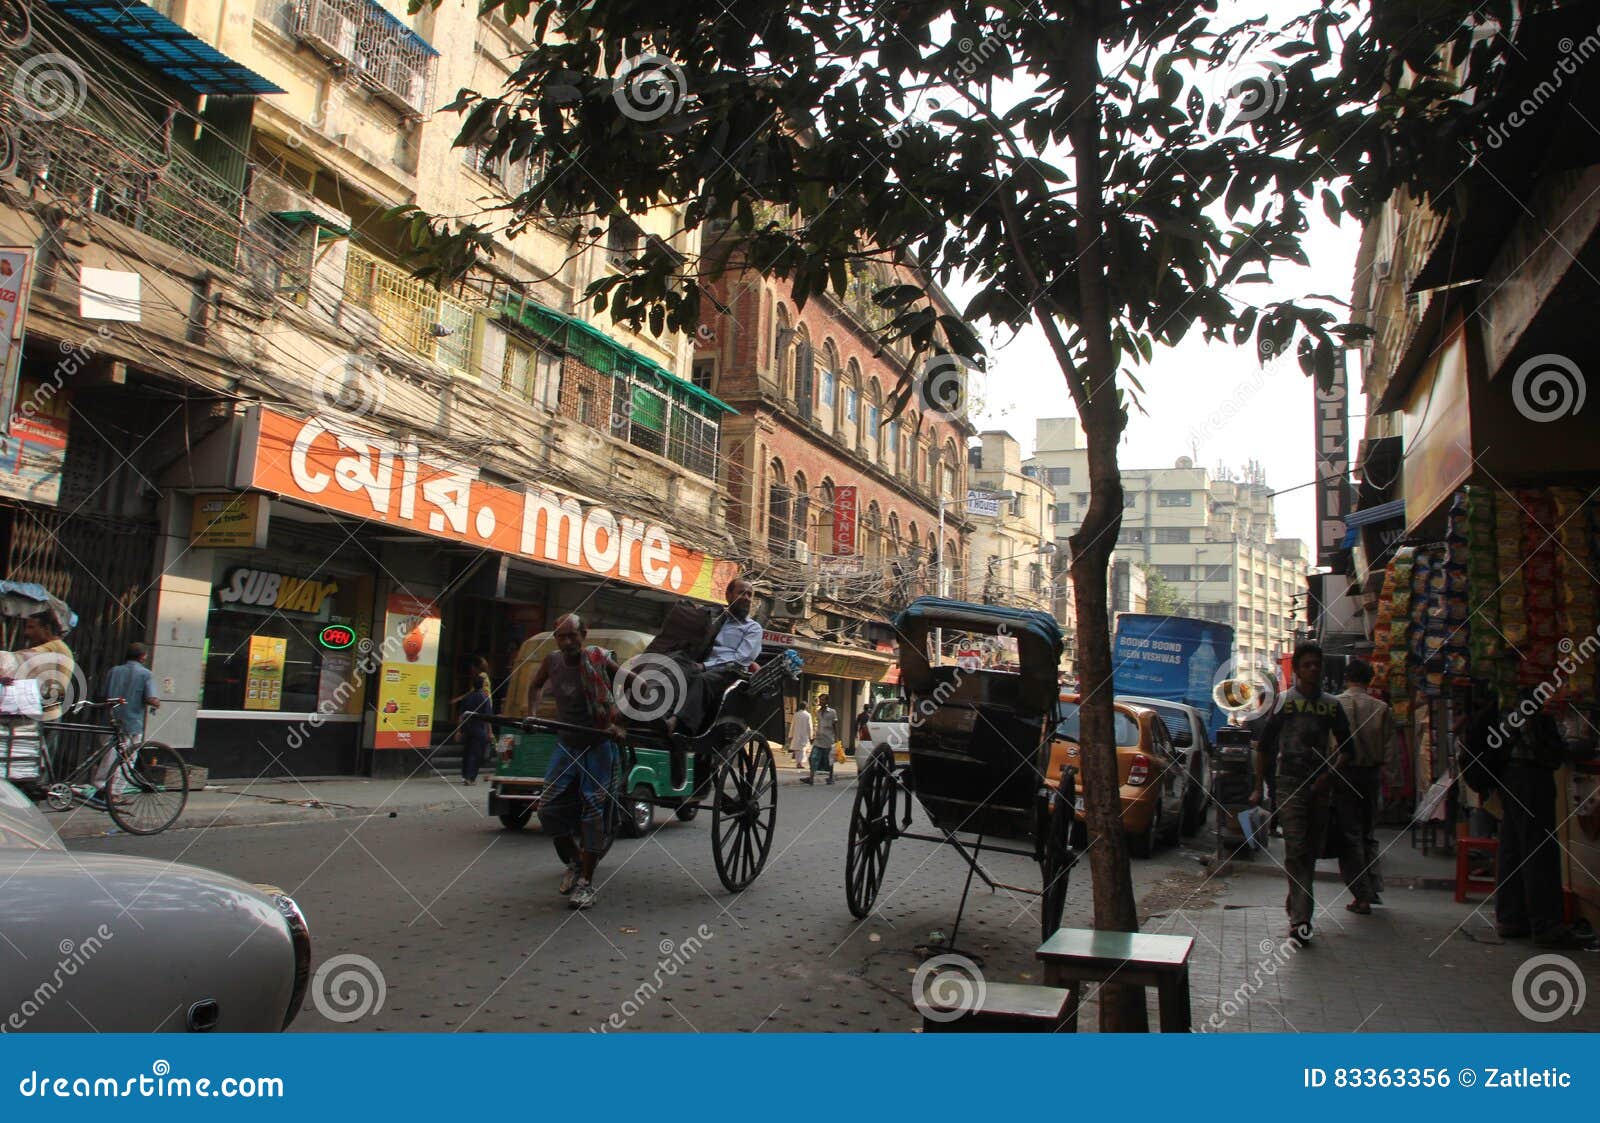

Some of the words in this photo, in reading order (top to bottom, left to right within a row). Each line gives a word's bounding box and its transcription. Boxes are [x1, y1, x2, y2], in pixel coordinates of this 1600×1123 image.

[519, 486, 683, 590] more.
[219, 568, 339, 614] SUBWAY
[323, 629, 349, 645] OPEN
[762, 630, 793, 644] RINCE
[1283, 700, 1337, 717] EVADE
